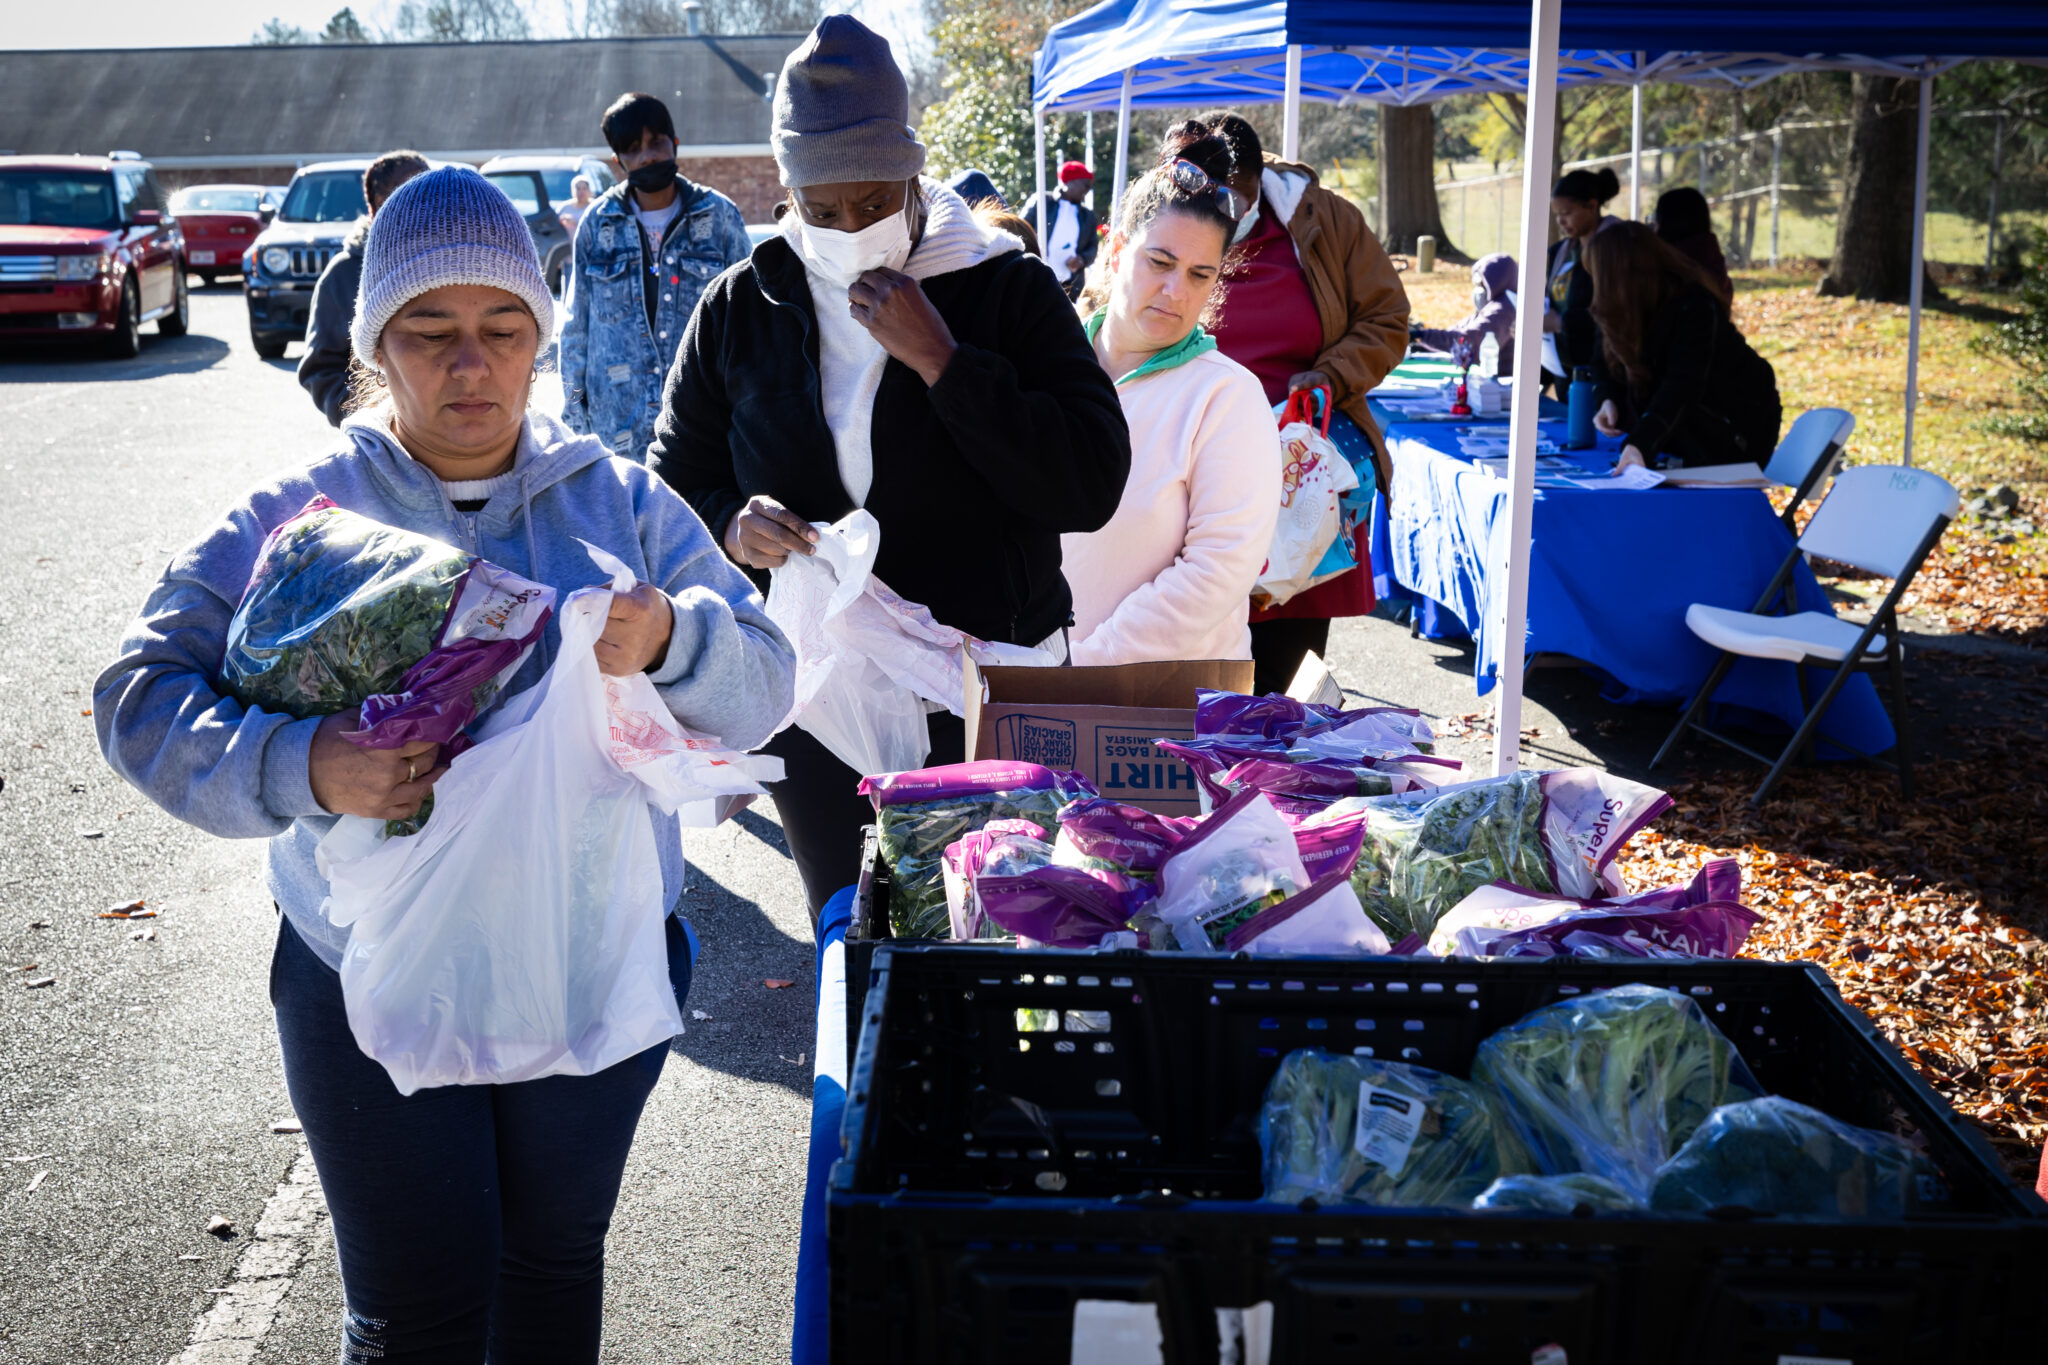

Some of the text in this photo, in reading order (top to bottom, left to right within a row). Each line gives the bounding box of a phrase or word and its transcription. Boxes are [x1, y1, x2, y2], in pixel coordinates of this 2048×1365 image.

[1023, 724, 1072, 741] GRACIAS
[1023, 735, 1072, 748] THANK YOU
[1105, 735, 1155, 745] AMISETA
[1023, 745, 1072, 758] GRACIAS
[1105, 745, 1149, 757] BAGS
[1043, 758, 1072, 767] THANK
[1105, 763, 1195, 790] HIRT
[1299, 844, 1350, 863] KEEP REFRIGERA
